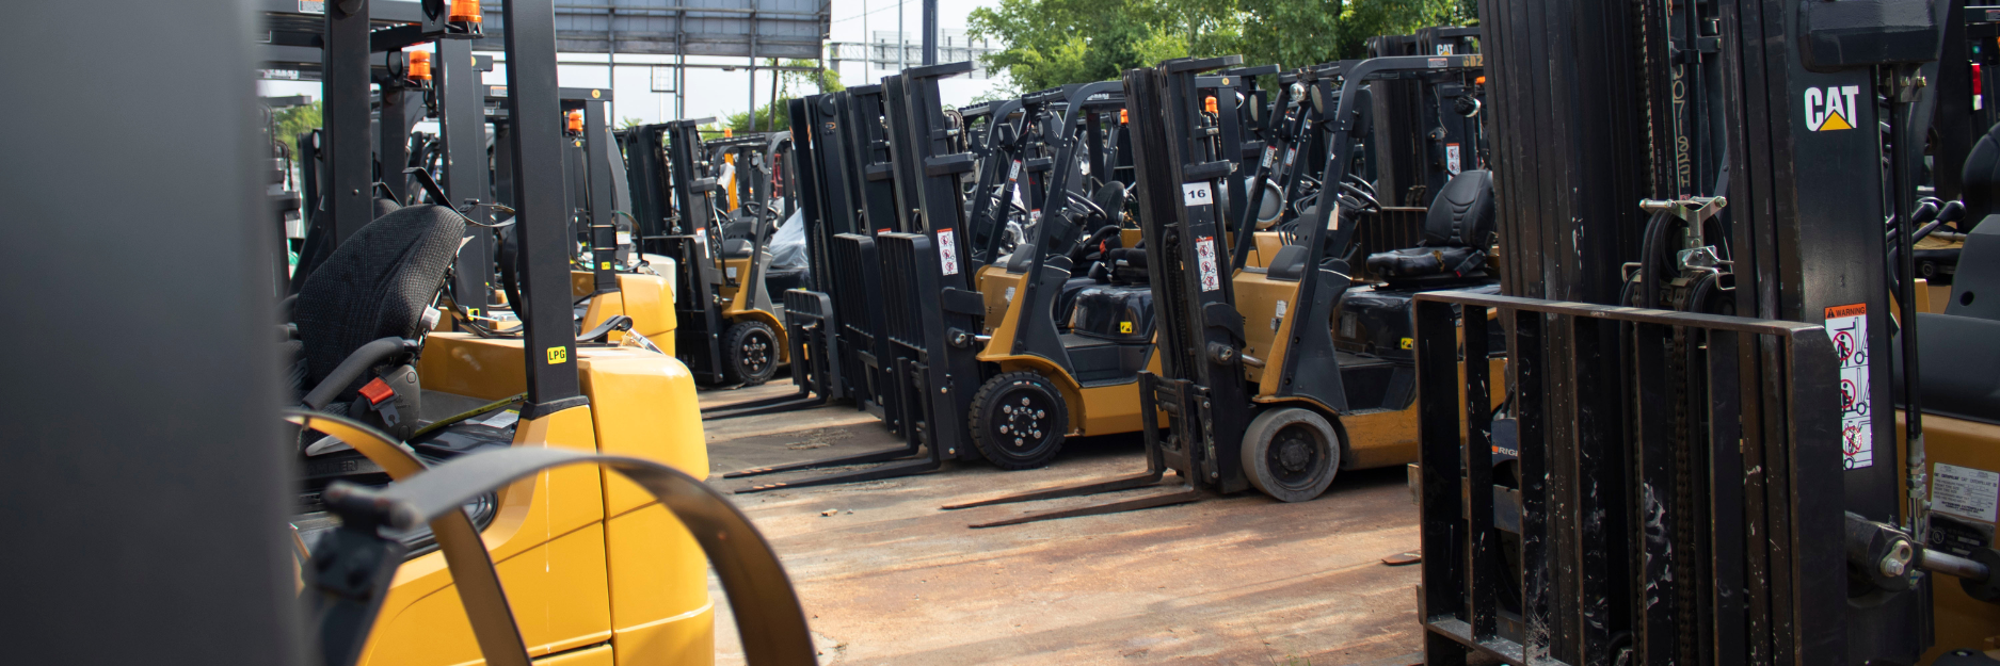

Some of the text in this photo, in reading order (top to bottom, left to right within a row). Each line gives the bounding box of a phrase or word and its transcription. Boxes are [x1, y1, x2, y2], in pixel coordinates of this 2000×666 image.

[1437, 44, 1453, 56] CAT
[1804, 85, 1859, 131] CAT
[1188, 189, 1206, 198] 16
[1836, 306, 1865, 317] WARNING
[549, 349, 565, 360] LPG
